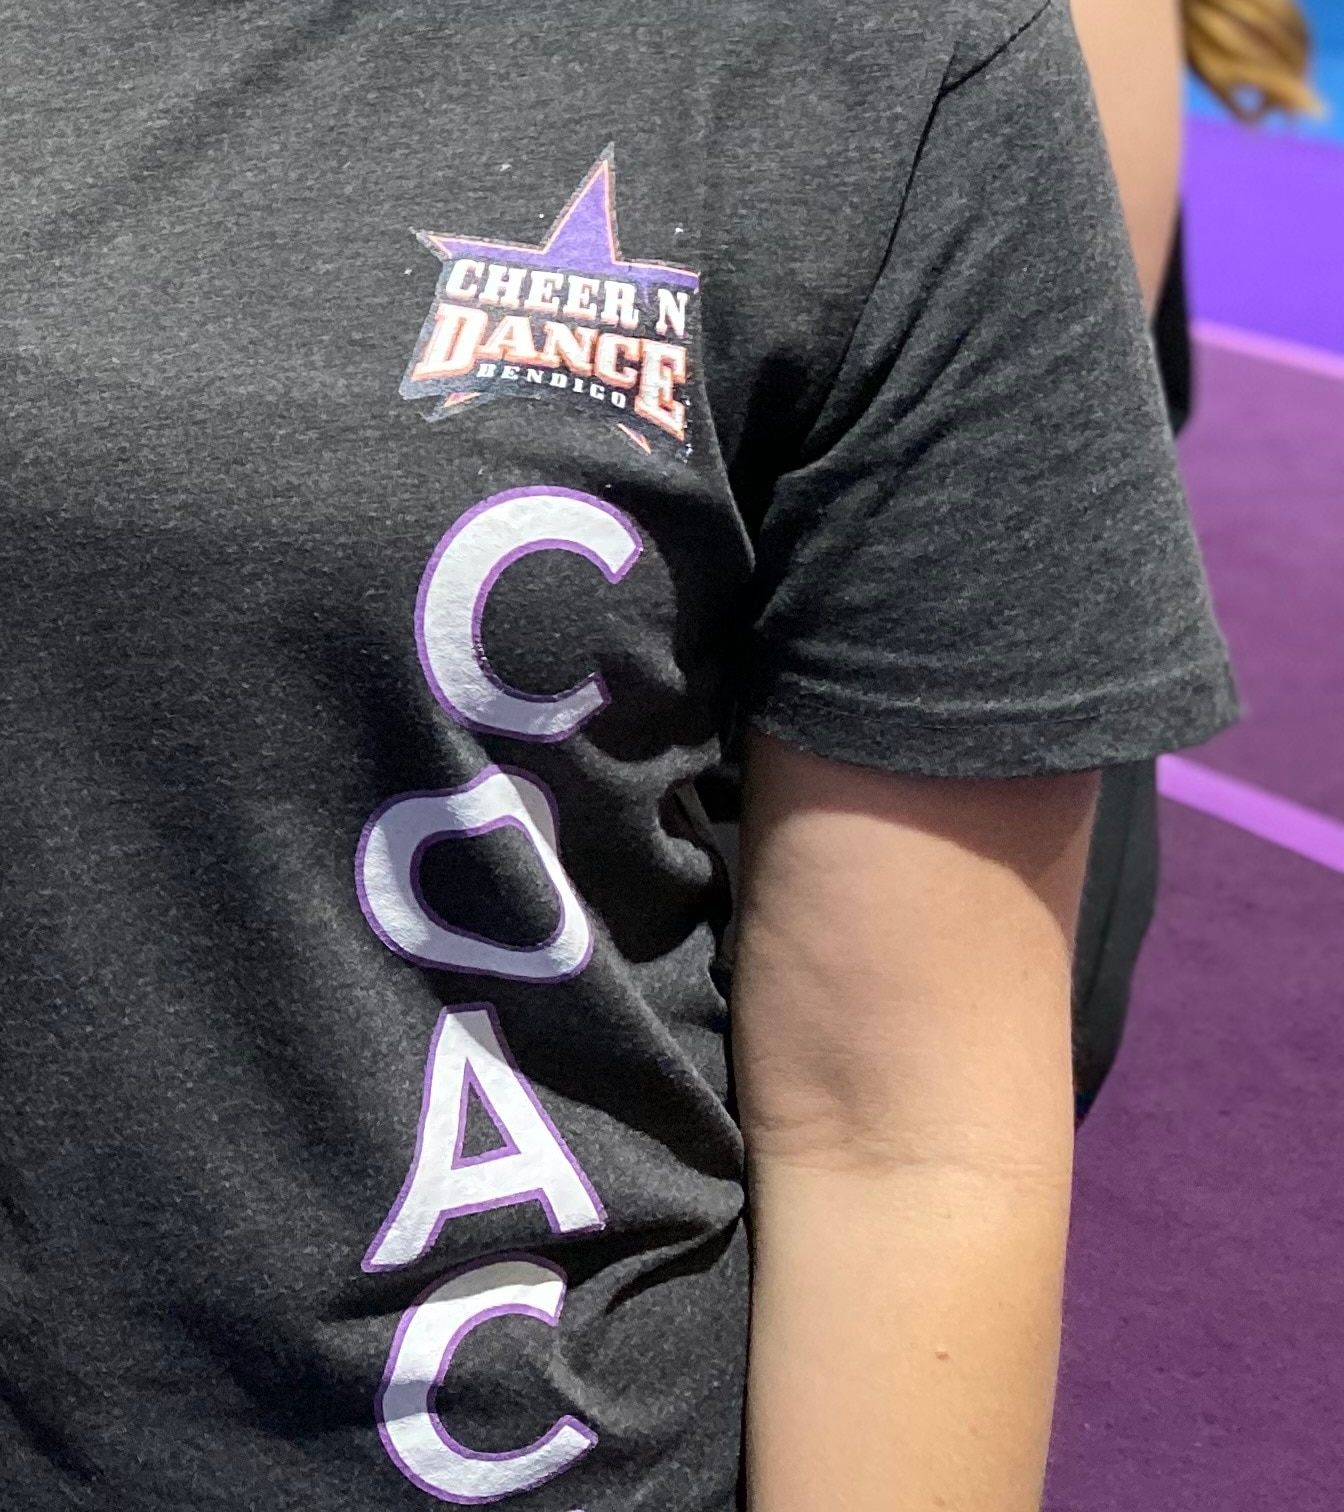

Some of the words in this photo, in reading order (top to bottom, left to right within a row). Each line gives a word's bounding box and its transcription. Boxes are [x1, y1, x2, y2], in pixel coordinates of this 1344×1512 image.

[444, 258, 640, 330] CHEER
[655, 288, 689, 338] N
[411, 302, 688, 442] DANCE
[353, 486, 644, 1512] COAC
